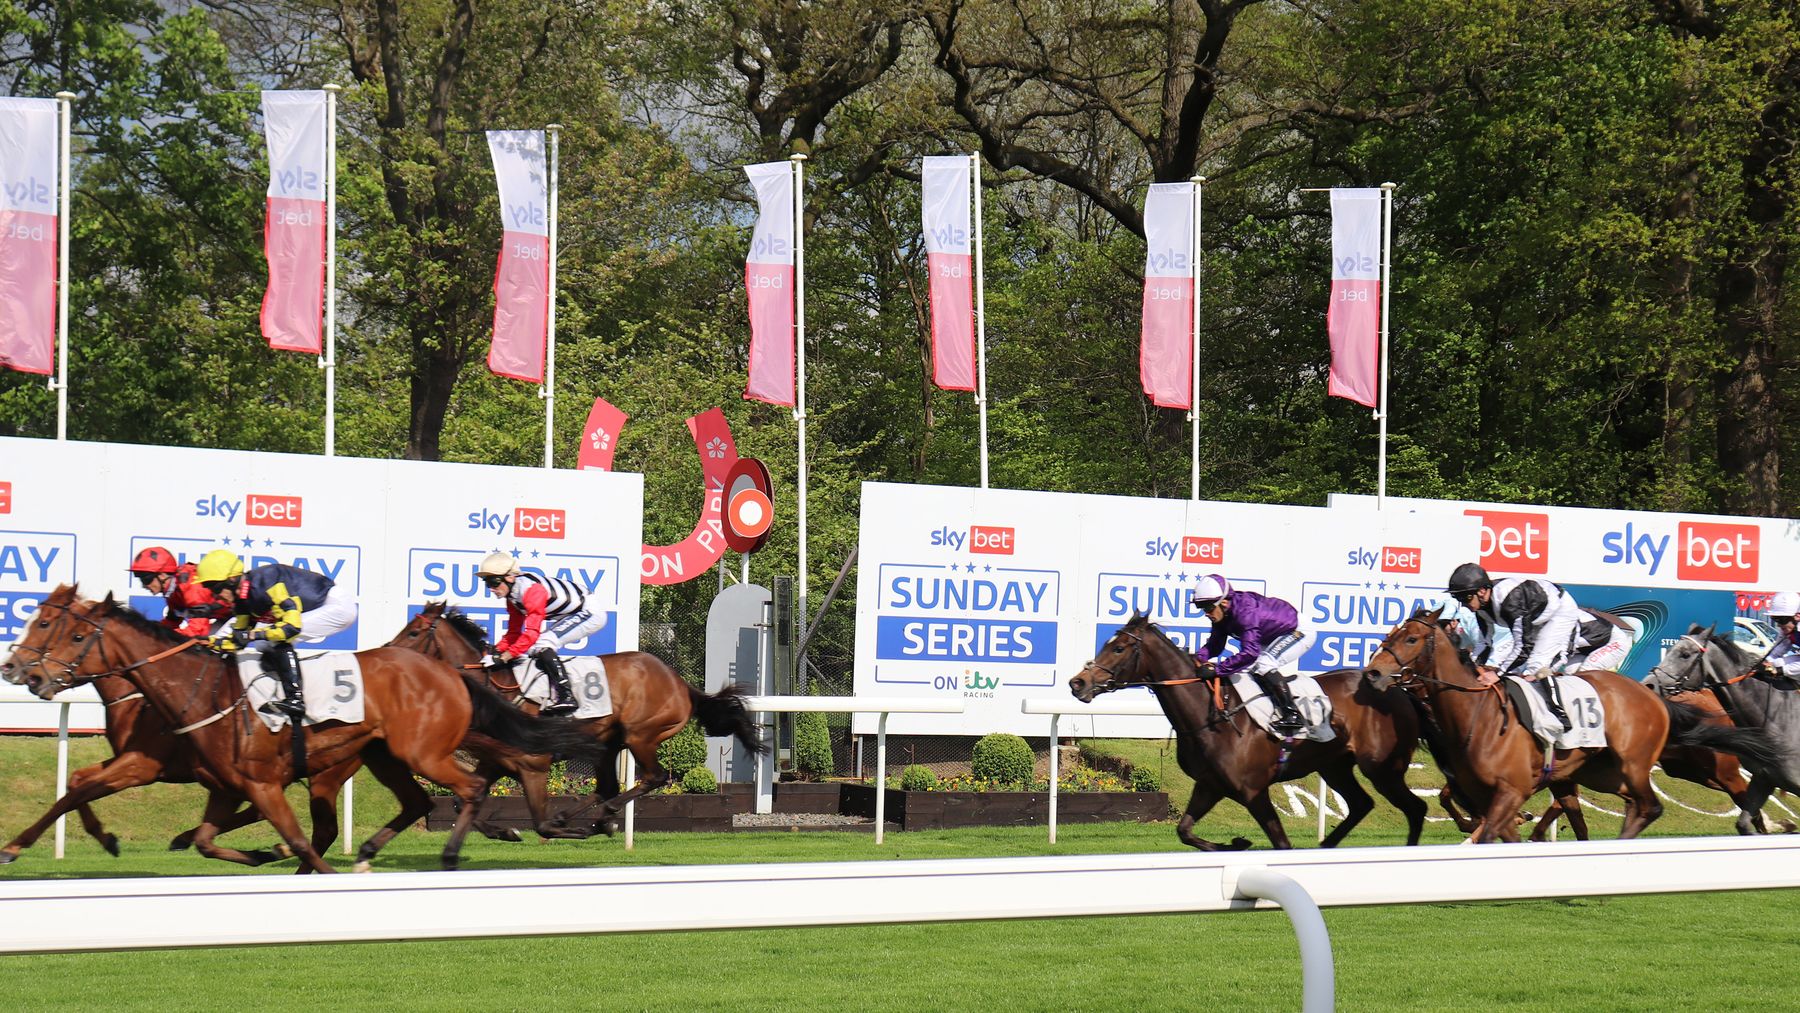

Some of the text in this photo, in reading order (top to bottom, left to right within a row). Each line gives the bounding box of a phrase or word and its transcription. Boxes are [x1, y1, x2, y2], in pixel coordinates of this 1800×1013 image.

[195, 494, 297, 522] sky bet
[467, 508, 561, 534] sky bet
[931, 526, 1011, 551] sky bet
[1145, 537, 1220, 561] sky bet
[1602, 522, 1752, 576] sky bet
[1347, 547, 1418, 570] sky bet
[890, 576, 1048, 613] SUNDAY
[1108, 585, 1206, 618] SUND
[1311, 593, 1438, 626] SUNDA
[902, 622, 1033, 659] SERIES
[333, 669, 357, 703] 5
[583, 671, 604, 701] 8
[934, 669, 1000, 690] ON itv
[964, 691, 994, 699] RACING
[1572, 697, 1602, 729] 13
